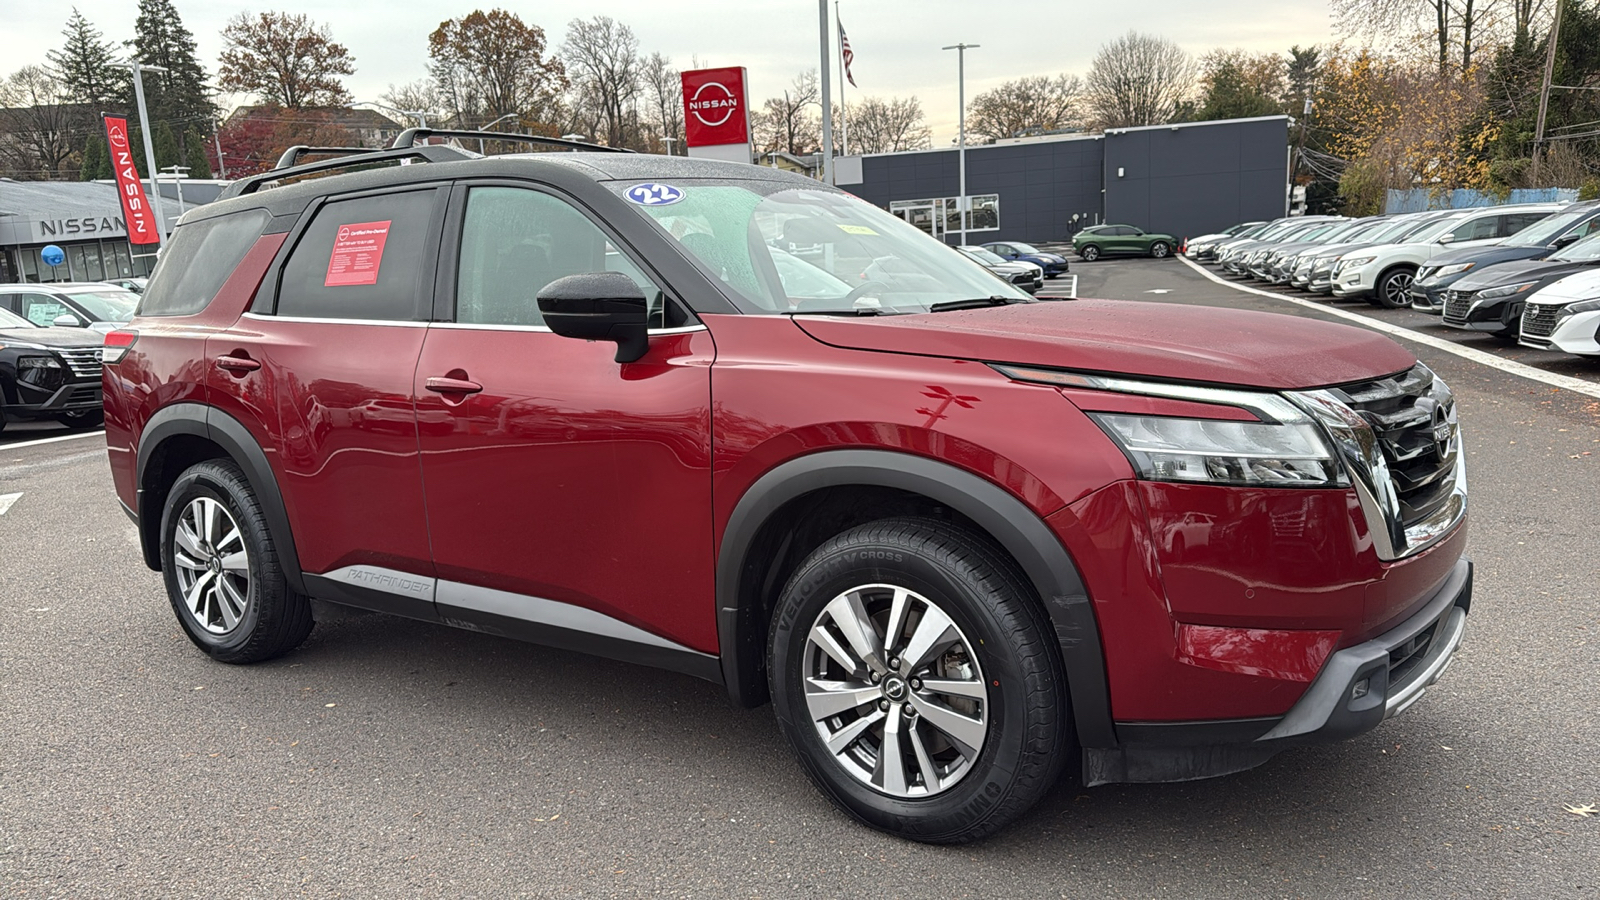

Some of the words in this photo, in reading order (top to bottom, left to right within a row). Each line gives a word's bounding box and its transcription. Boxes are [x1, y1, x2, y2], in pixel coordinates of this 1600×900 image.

[689, 98, 737, 110] NISSAN
[117, 151, 147, 233] NISSAN
[633, 184, 678, 204] 22
[41, 216, 126, 236] NISSAN
[346, 568, 432, 593] PATHFINDER
[778, 552, 858, 632] VELOCITY
[859, 551, 903, 563] CROSS
